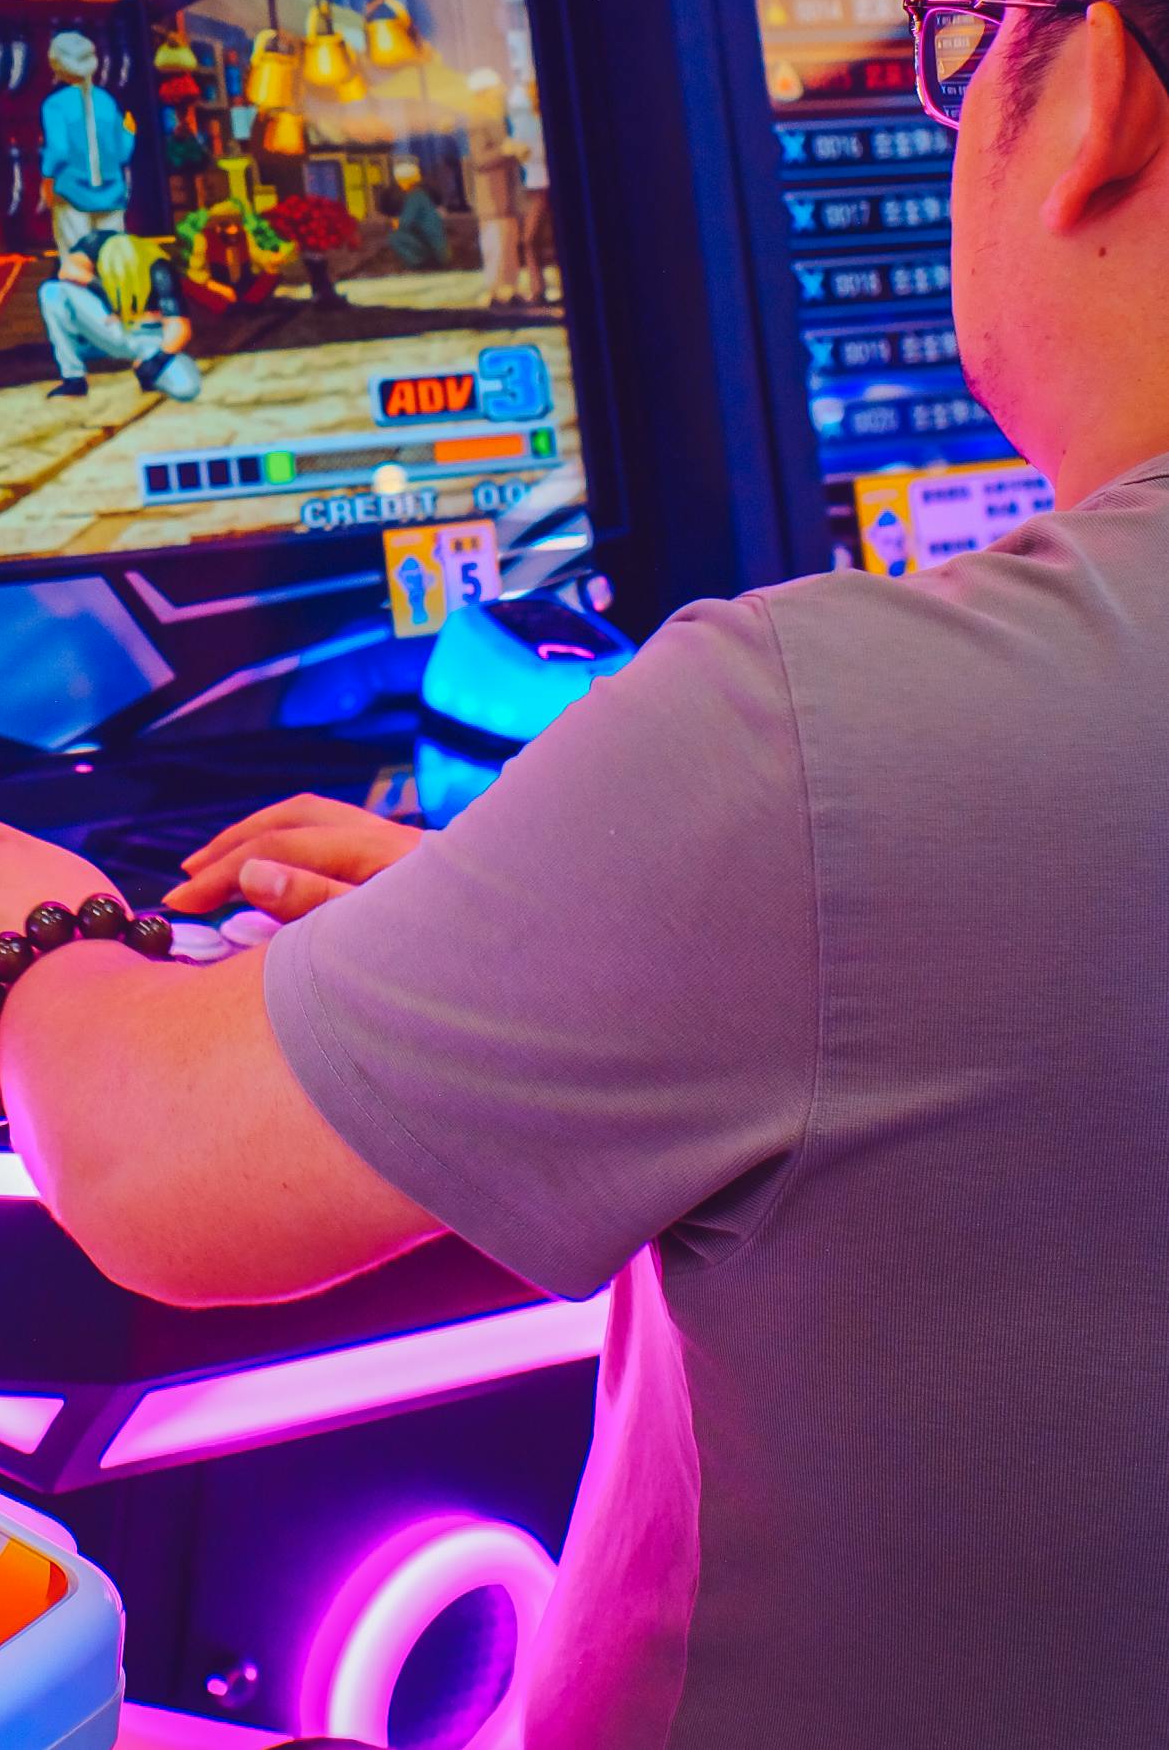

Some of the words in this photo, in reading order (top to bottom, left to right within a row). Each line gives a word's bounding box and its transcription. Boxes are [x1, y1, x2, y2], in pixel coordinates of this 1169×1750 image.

[385, 375, 474, 417] ADV
[479, 344, 553, 422] 3
[301, 488, 439, 530] CREDIT
[461, 562, 482, 608] 5
